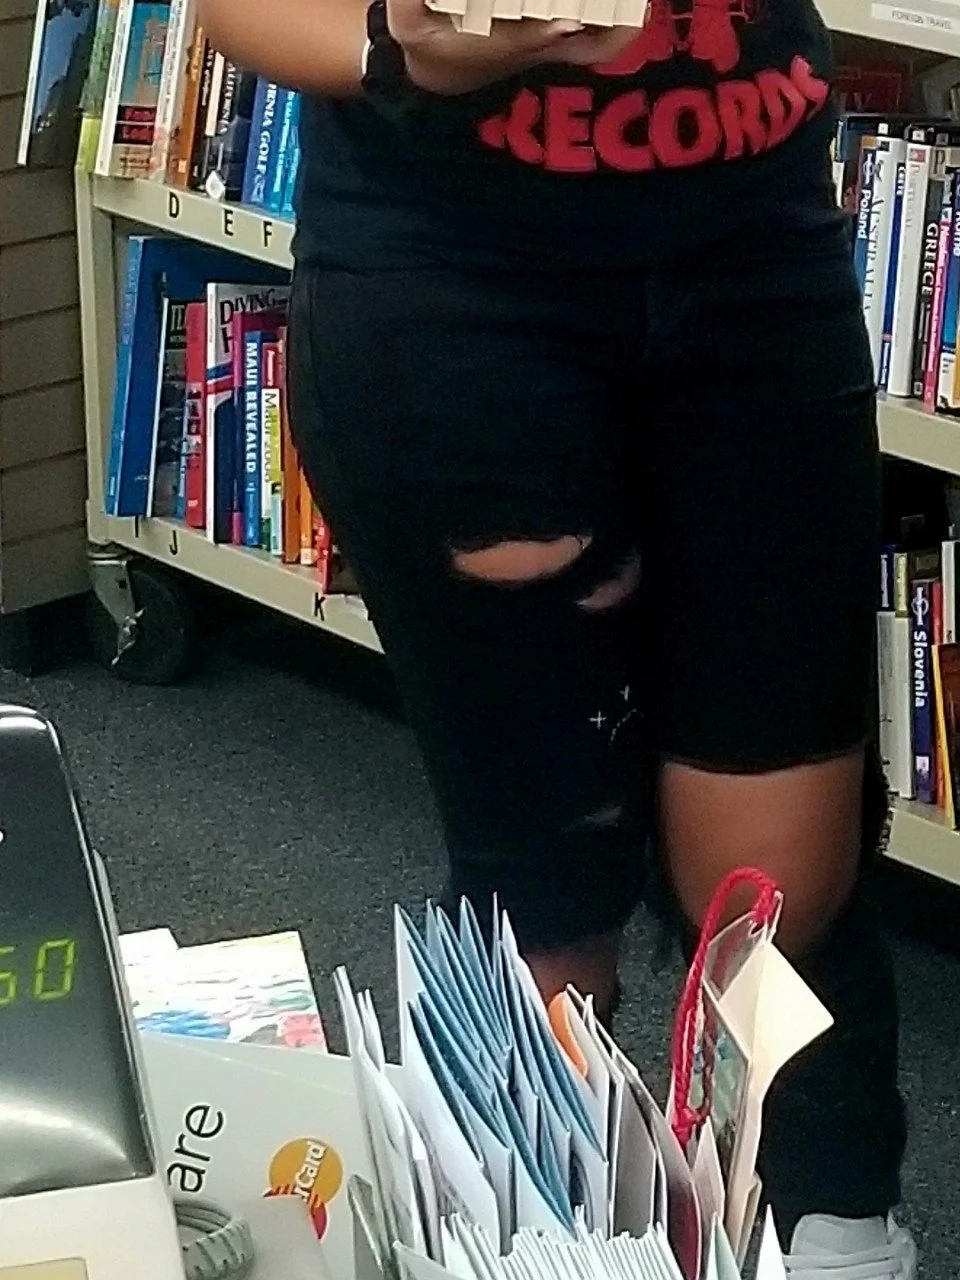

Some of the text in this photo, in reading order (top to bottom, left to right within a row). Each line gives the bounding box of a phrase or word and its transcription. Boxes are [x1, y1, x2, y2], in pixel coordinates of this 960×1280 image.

[255, 128, 274, 175] GOLF
[168, 191, 274, 248] D E F
[856, 189, 873, 239] Poland
[920, 222, 939, 296] GREECE
[244, 342, 259, 474] MAUI REVEALED
[168, 530, 179, 556] J
[313, 591, 327, 622] K
[913, 630, 931, 708] Slovenia
[166, 1104, 226, 1193] are
